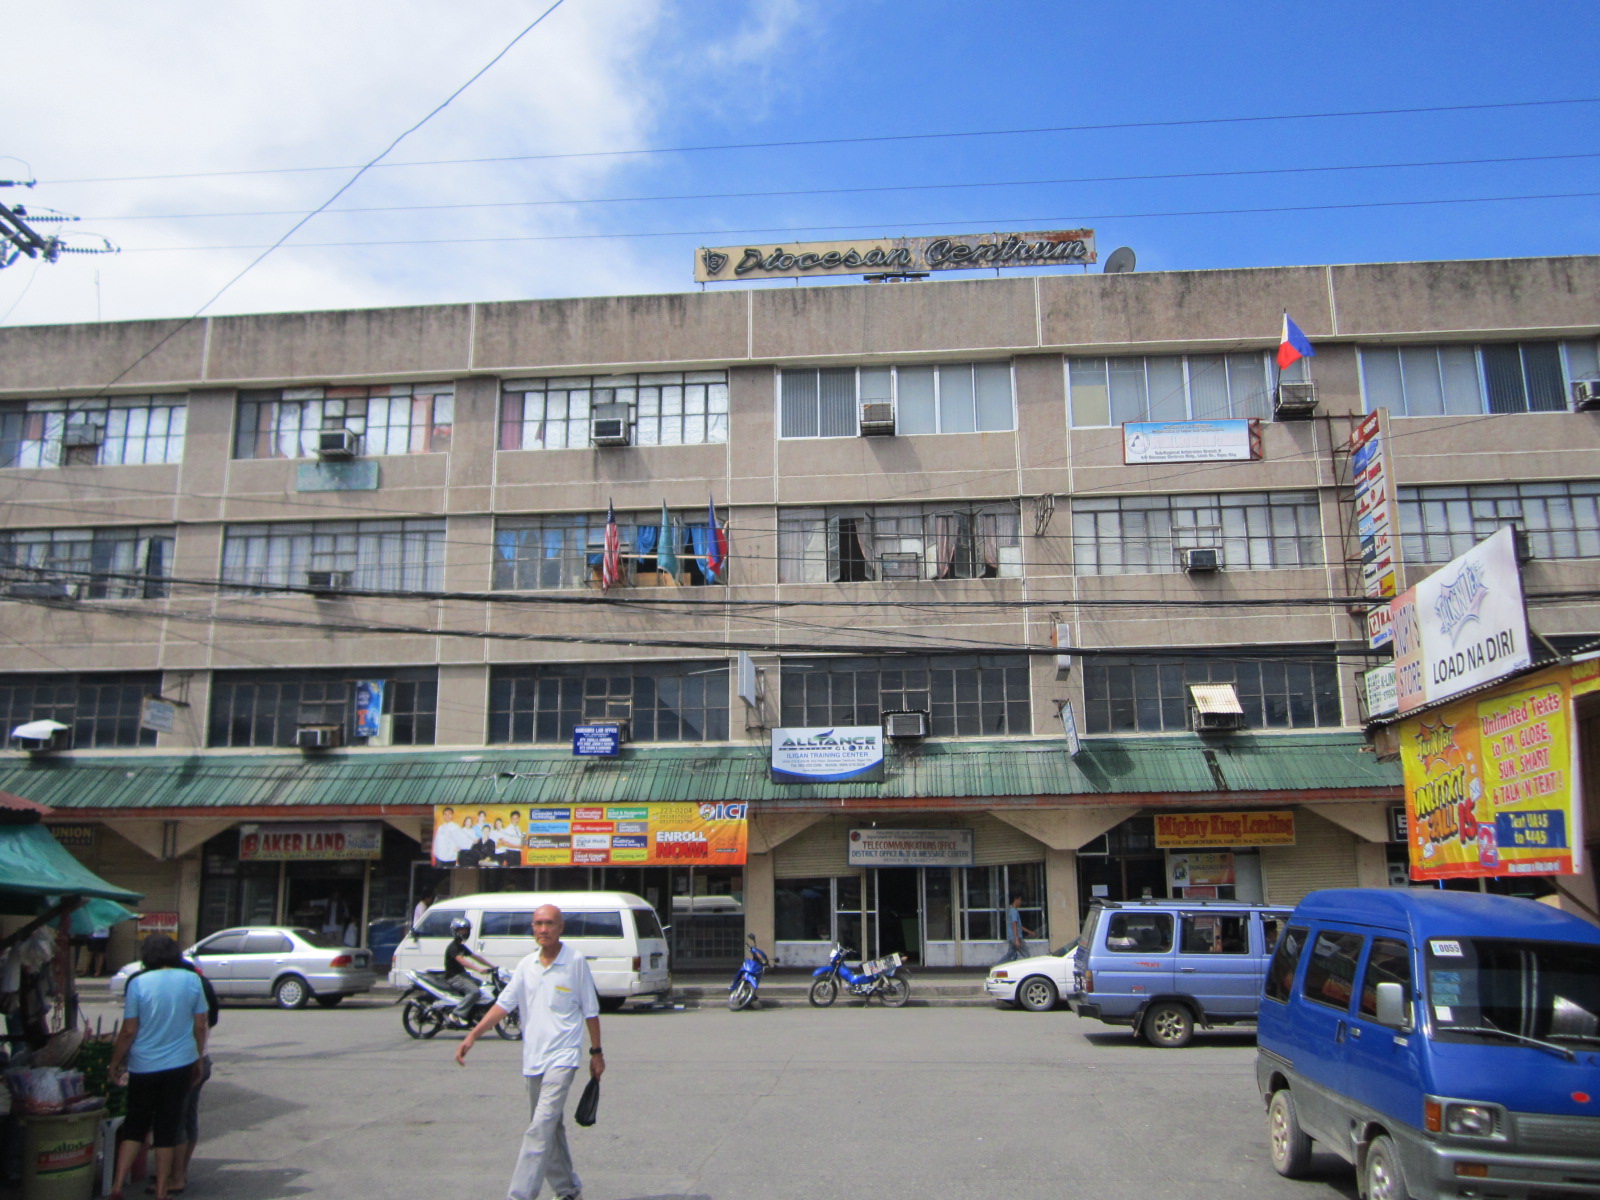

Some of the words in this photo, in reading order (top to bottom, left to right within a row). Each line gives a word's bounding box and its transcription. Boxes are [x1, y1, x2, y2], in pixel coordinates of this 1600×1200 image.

[734, 247, 911, 275] Diocesan
[924, 236, 1087, 267] Centrum
[1433, 652, 1465, 684] LOAD
[1467, 643, 1485, 671] NA
[1486, 628, 1515, 663] DIRI
[1400, 660, 1422, 698] STORE
[1481, 700, 1528, 736] Unlimited
[1529, 693, 1560, 718] Texts
[782, 736, 876, 746] ALLIANCE
[1492, 742, 1500, 757] to
[1519, 721, 1552, 746] GLOBE,
[1499, 759, 1519, 780] SUN,
[1520, 748, 1549, 774] SMART
[1500, 781, 1521, 803] TALK
[1533, 772, 1556, 795] TEXT
[52, 827, 92, 838] UNION
[656, 831, 707, 842] ENROLL
[1157, 815, 1208, 838] Mighty
[1210, 814, 1242, 838] King
[1242, 813, 1294, 836] Lending
[242, 832, 304, 854] BAKER
[306, 832, 346, 851] LAND
[656, 842, 708, 858] NOW!
[862, 841, 937, 850] TELECOMMUNICATIONS
[937, 841, 957, 850] OFFICE
[1439, 944, 1460, 953] 0055
